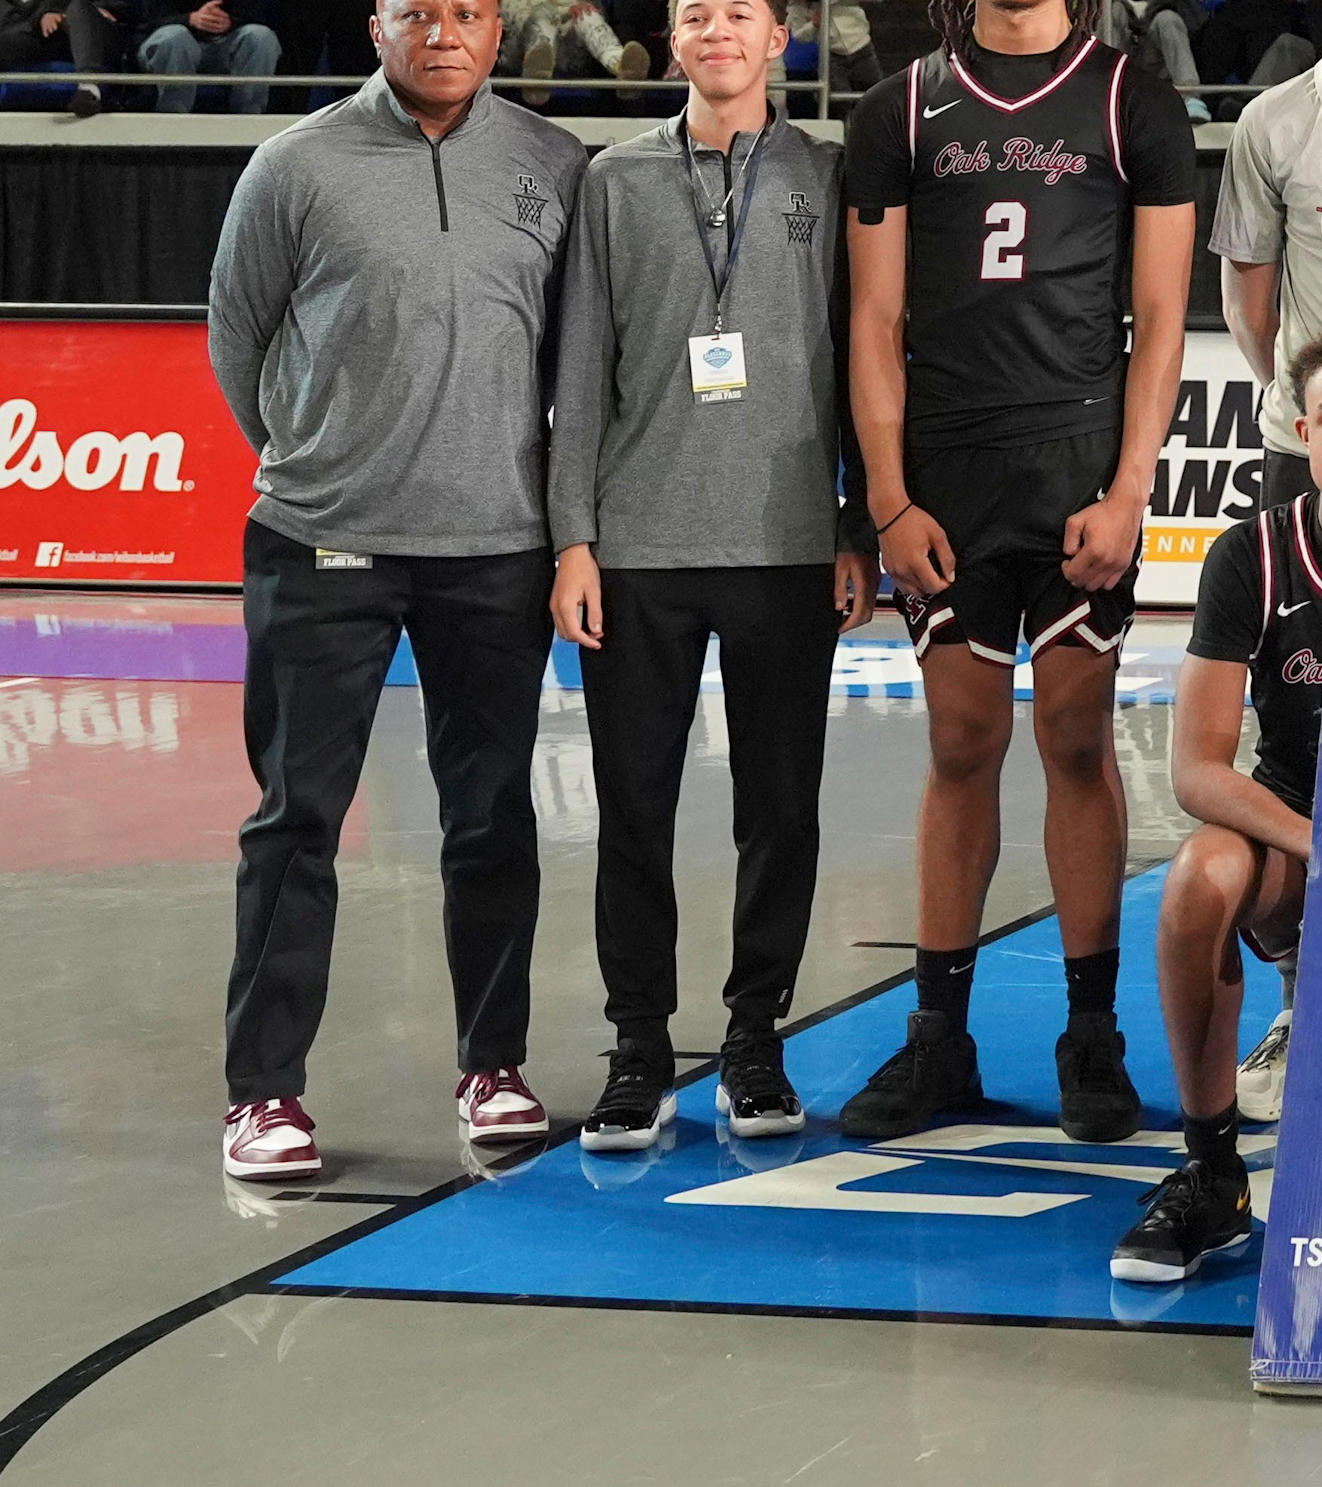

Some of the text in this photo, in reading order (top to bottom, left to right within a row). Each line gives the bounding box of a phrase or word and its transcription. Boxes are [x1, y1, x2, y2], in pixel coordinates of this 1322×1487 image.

[933, 137, 1088, 185] Oak Ridge
[980, 200, 1028, 282] 2
